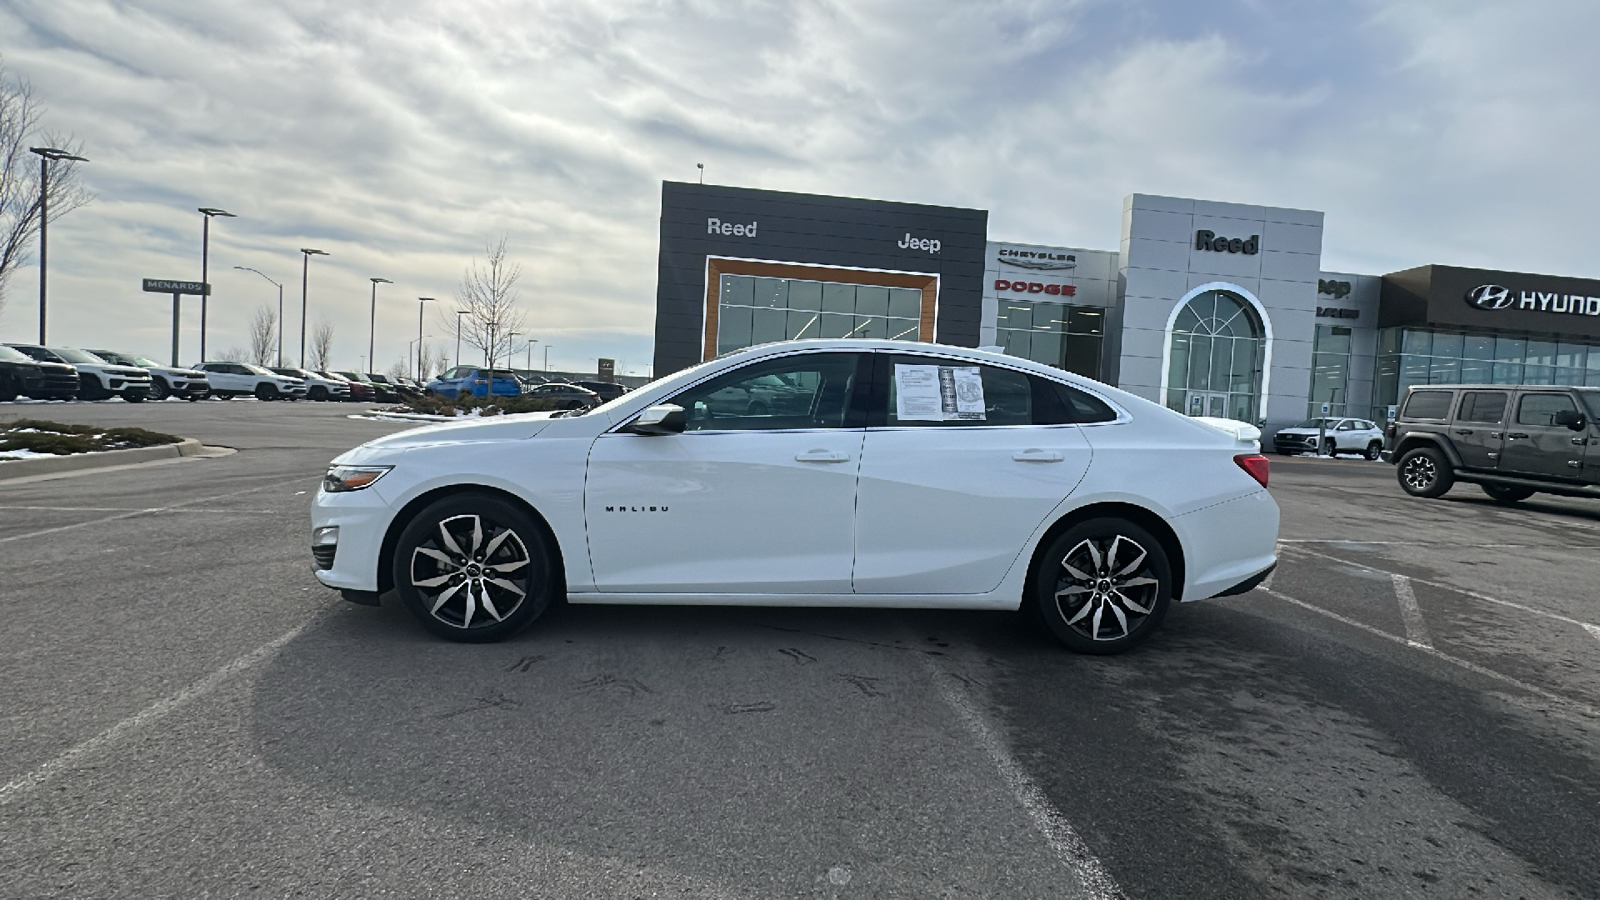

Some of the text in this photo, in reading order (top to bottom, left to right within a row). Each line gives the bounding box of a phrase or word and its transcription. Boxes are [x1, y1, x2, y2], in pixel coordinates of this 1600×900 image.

[707, 217, 758, 238] Reed
[897, 232, 941, 254] Jeep
[1196, 229, 1260, 255] Reed
[999, 249, 1076, 262] CHRYSLER
[147, 280, 203, 291] MENARDS
[995, 279, 1077, 297] DODGE
